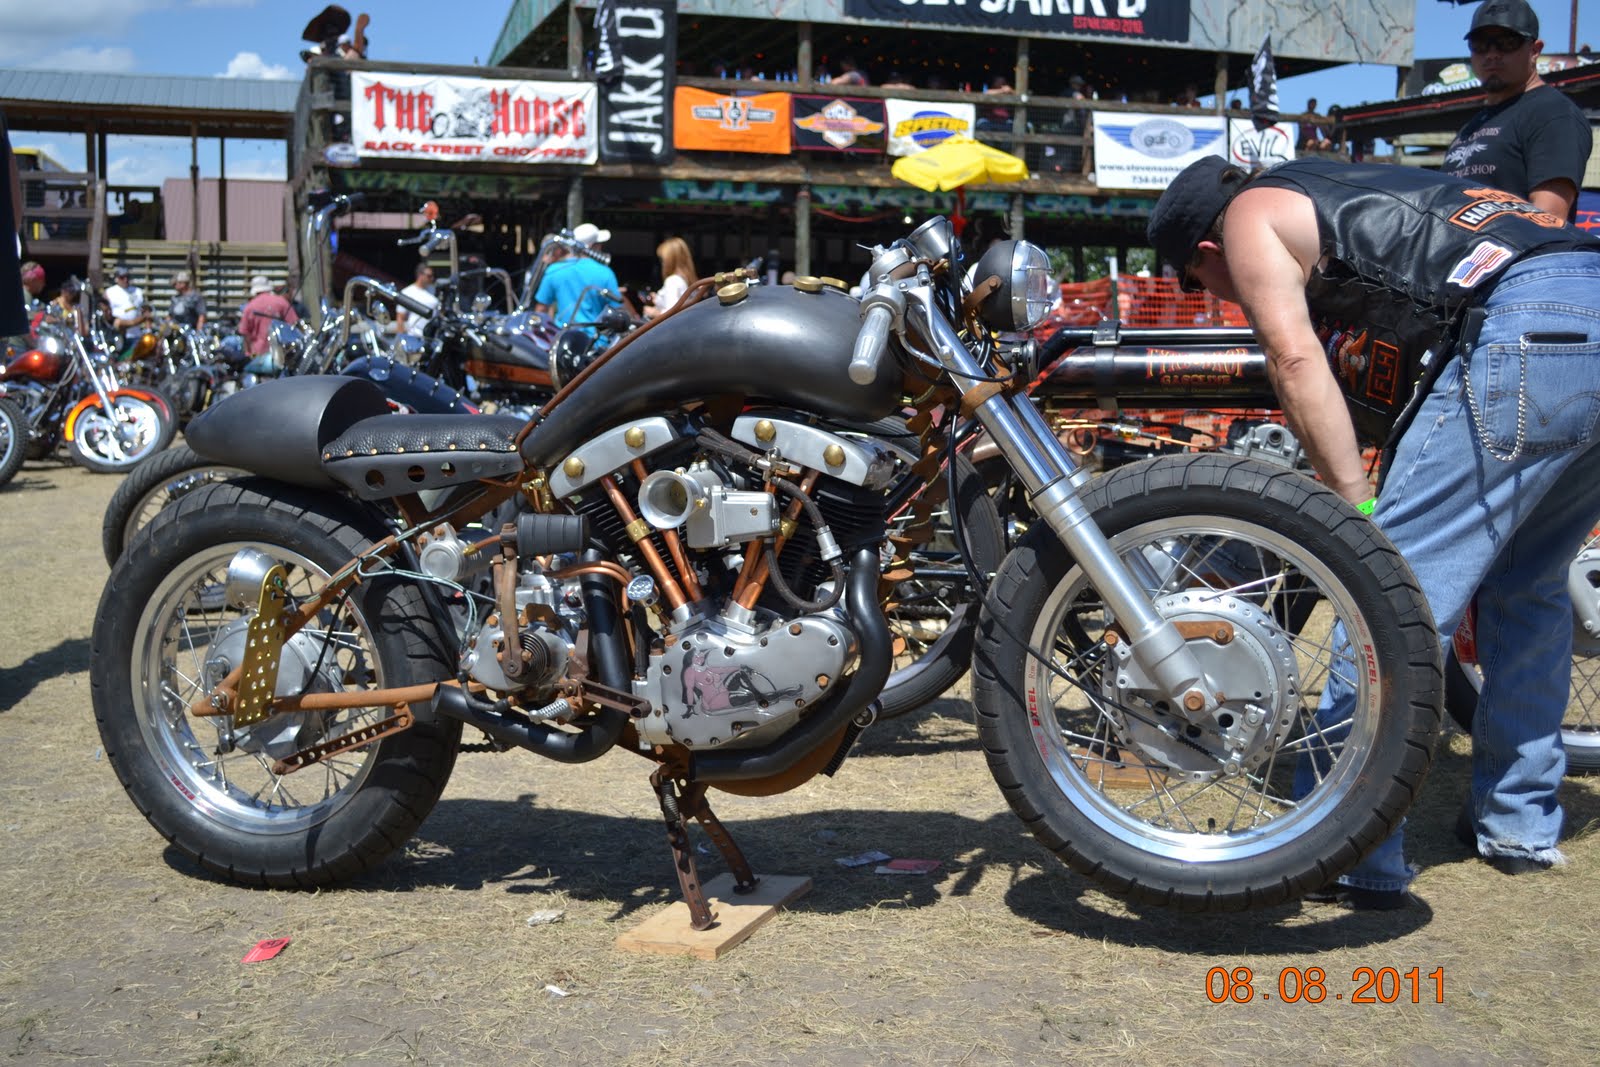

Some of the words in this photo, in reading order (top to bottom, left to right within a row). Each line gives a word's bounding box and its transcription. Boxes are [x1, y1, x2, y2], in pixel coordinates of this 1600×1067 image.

[364, 81, 433, 132] THE
[364, 140, 415, 152] BACK
[420, 143, 484, 156] STREET
[1240, 131, 1288, 161] EVIL
[1471, 163, 1496, 175] SHOP
[1374, 351, 1395, 392] FLH
[1363, 643, 1377, 685] EXCEL
[1028, 687, 1040, 727] EXCEL
